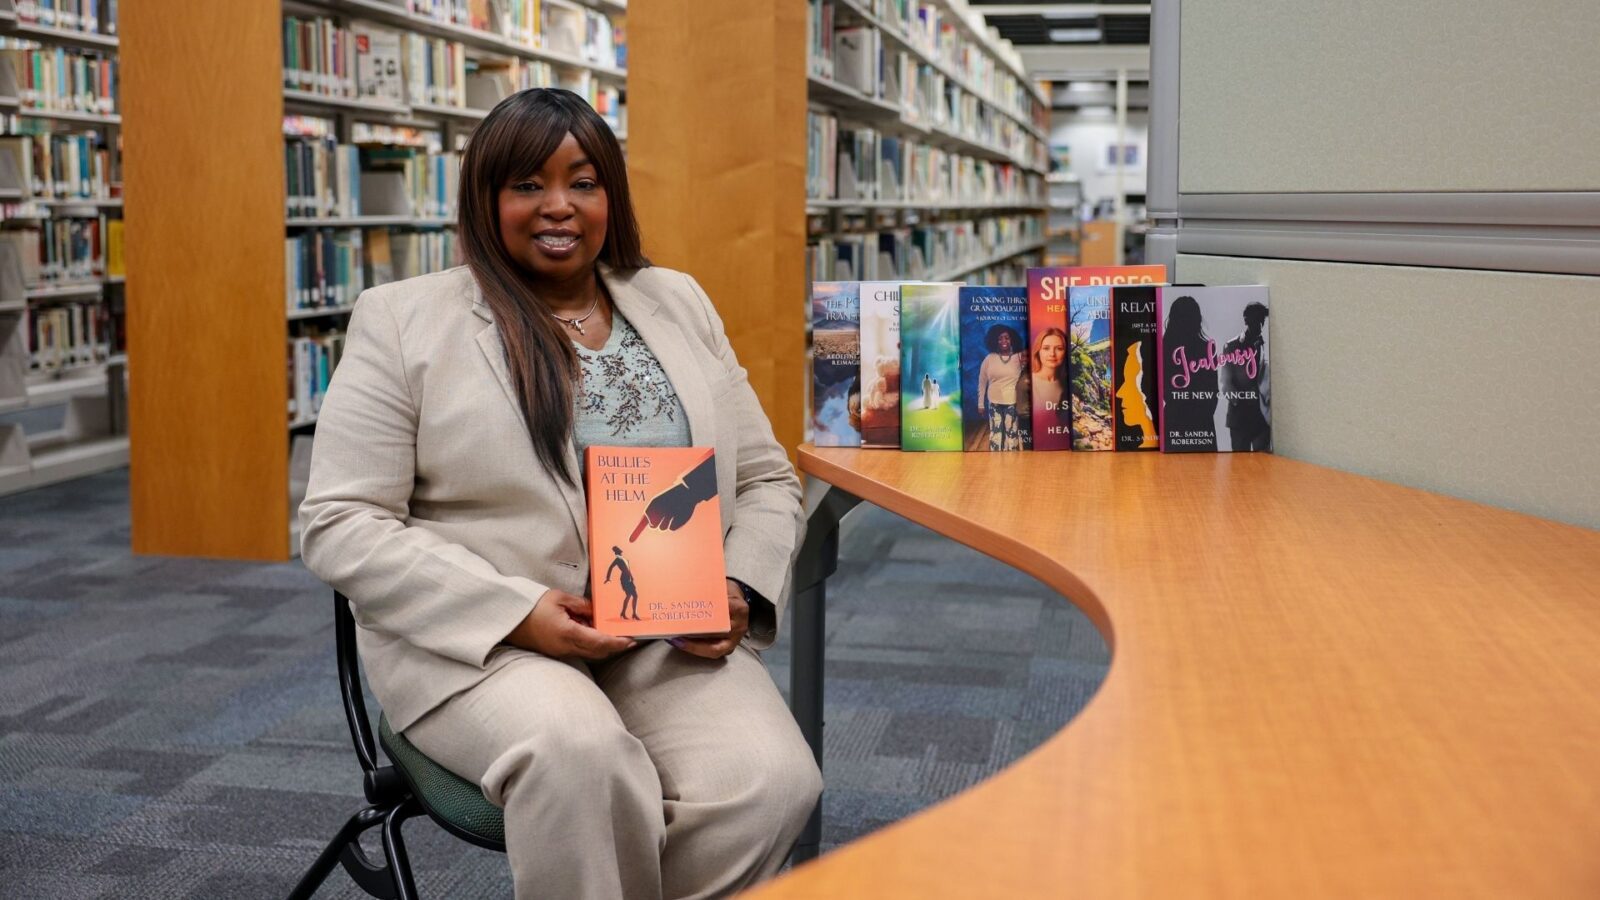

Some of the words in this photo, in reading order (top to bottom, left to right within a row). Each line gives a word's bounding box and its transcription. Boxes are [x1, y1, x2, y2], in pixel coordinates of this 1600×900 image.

[826, 300, 844, 309] THE
[972, 296, 1005, 304] LOOKING
[1121, 302, 1156, 312] RELAT
[1171, 337, 1258, 389] Jealousy
[1172, 391, 1190, 400] THE
[1192, 391, 1214, 400] NEW
[1216, 391, 1258, 400] CANCER
[1045, 401, 1060, 411] Dr.
[1062, 401, 1069, 410] S
[1047, 426, 1070, 434] HEA
[597, 455, 651, 468] BULLIES
[600, 473, 618, 485] AT
[622, 473, 650, 485] THE
[606, 490, 646, 502] HELM
[649, 602, 668, 611] DR.
[670, 601, 714, 611] SANDRA
[652, 611, 713, 621] ROBERTSON
